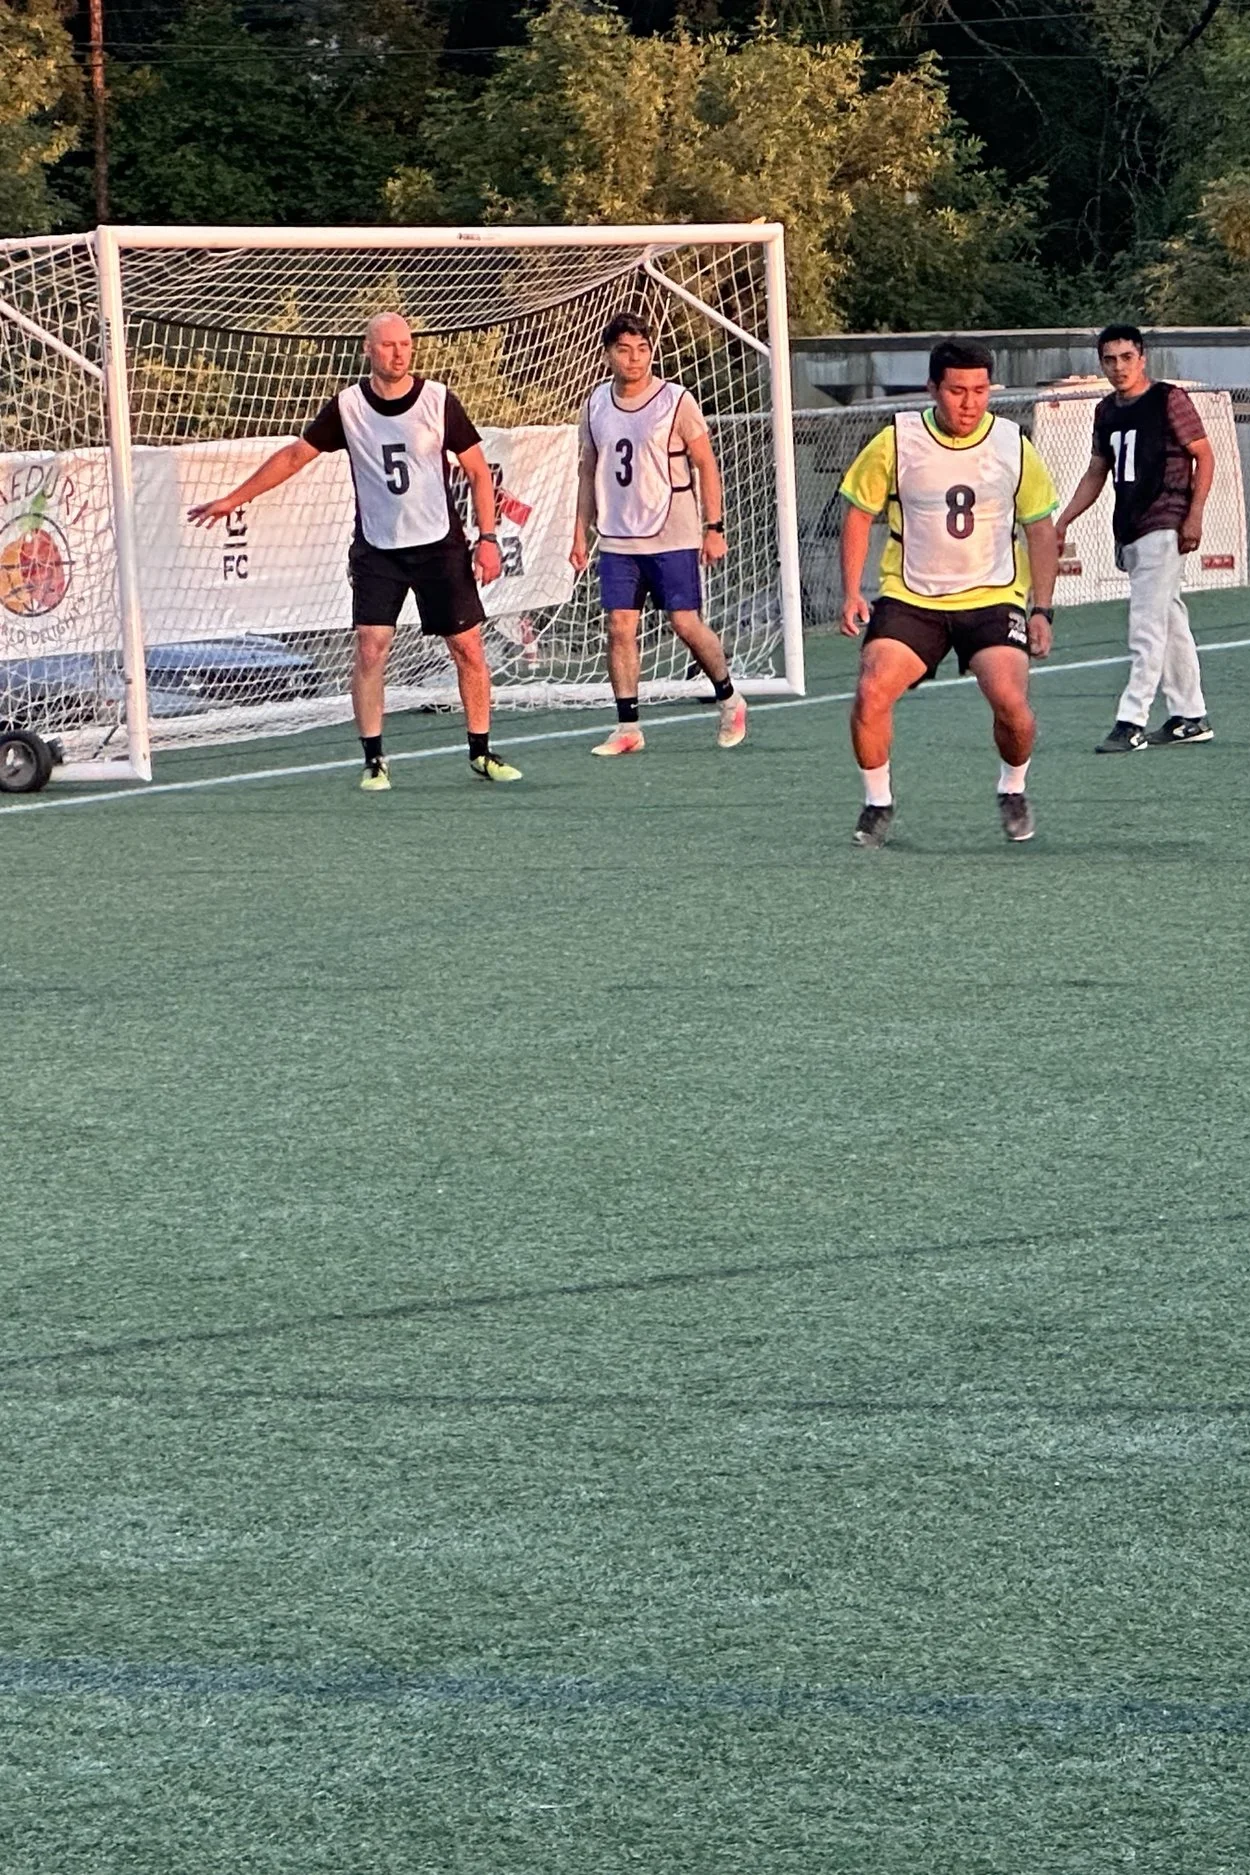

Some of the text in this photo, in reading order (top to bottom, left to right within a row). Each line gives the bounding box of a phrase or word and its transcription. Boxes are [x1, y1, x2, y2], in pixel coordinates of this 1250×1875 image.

[381, 442, 410, 495] 5
[615, 437, 633, 487] 3
[1110, 429, 1137, 483] 11
[945, 484, 976, 540] 8
[223, 554, 248, 580] FC
